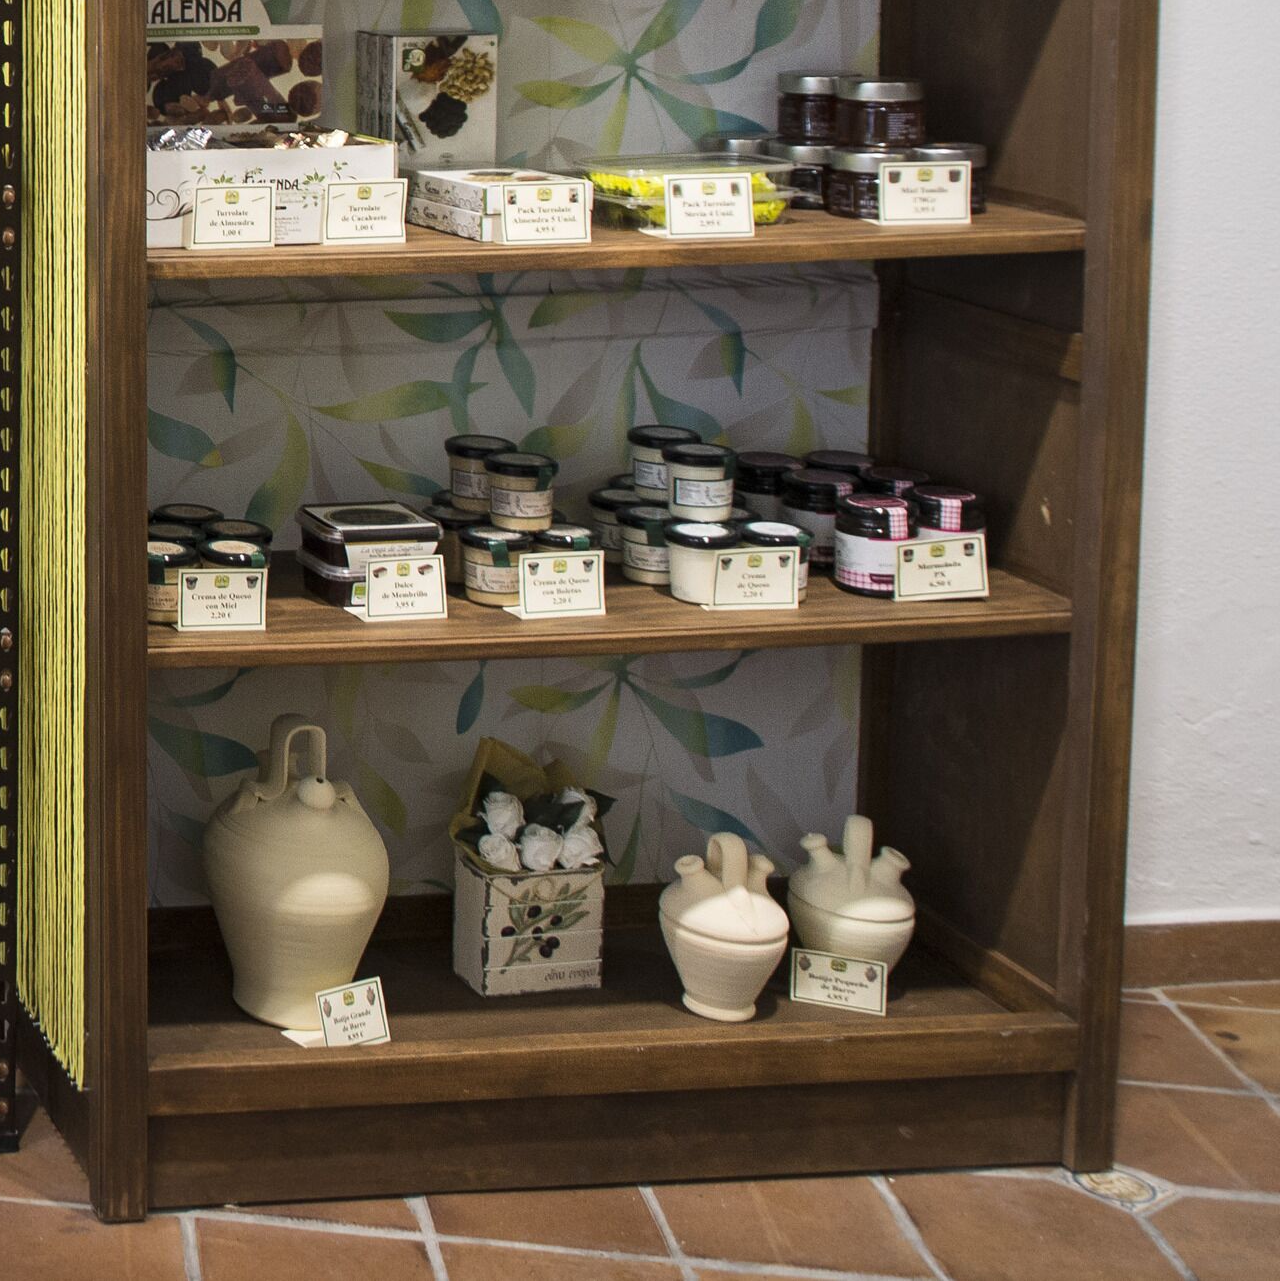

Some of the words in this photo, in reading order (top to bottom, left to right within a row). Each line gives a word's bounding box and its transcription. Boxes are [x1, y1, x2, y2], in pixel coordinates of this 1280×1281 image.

[701, 200, 736, 209] Turrolate
[215, 209, 249, 217] Turrolate
[348, 205, 381, 213] Turrolate
[517, 206, 535, 214] Pack
[537, 206, 572, 214] Turrolate
[351, 214, 387, 222] Cacahuete
[512, 216, 549, 225] Almendra
[219, 219, 255, 228] Almendra
[355, 224, 370, 232] 1,00
[222, 229, 237, 237] 1,00
[741, 572, 766, 581] Crema
[394, 581, 414, 589] Dulce
[533, 579, 557, 587] Crema
[568, 577, 591, 585] Queso
[747, 581, 771, 589] Queso
[391, 590, 428, 599] Membrillo
[556, 587, 582, 595] Boletus
[191, 593, 217, 602] Crema
[229, 592, 252, 602] Queso
